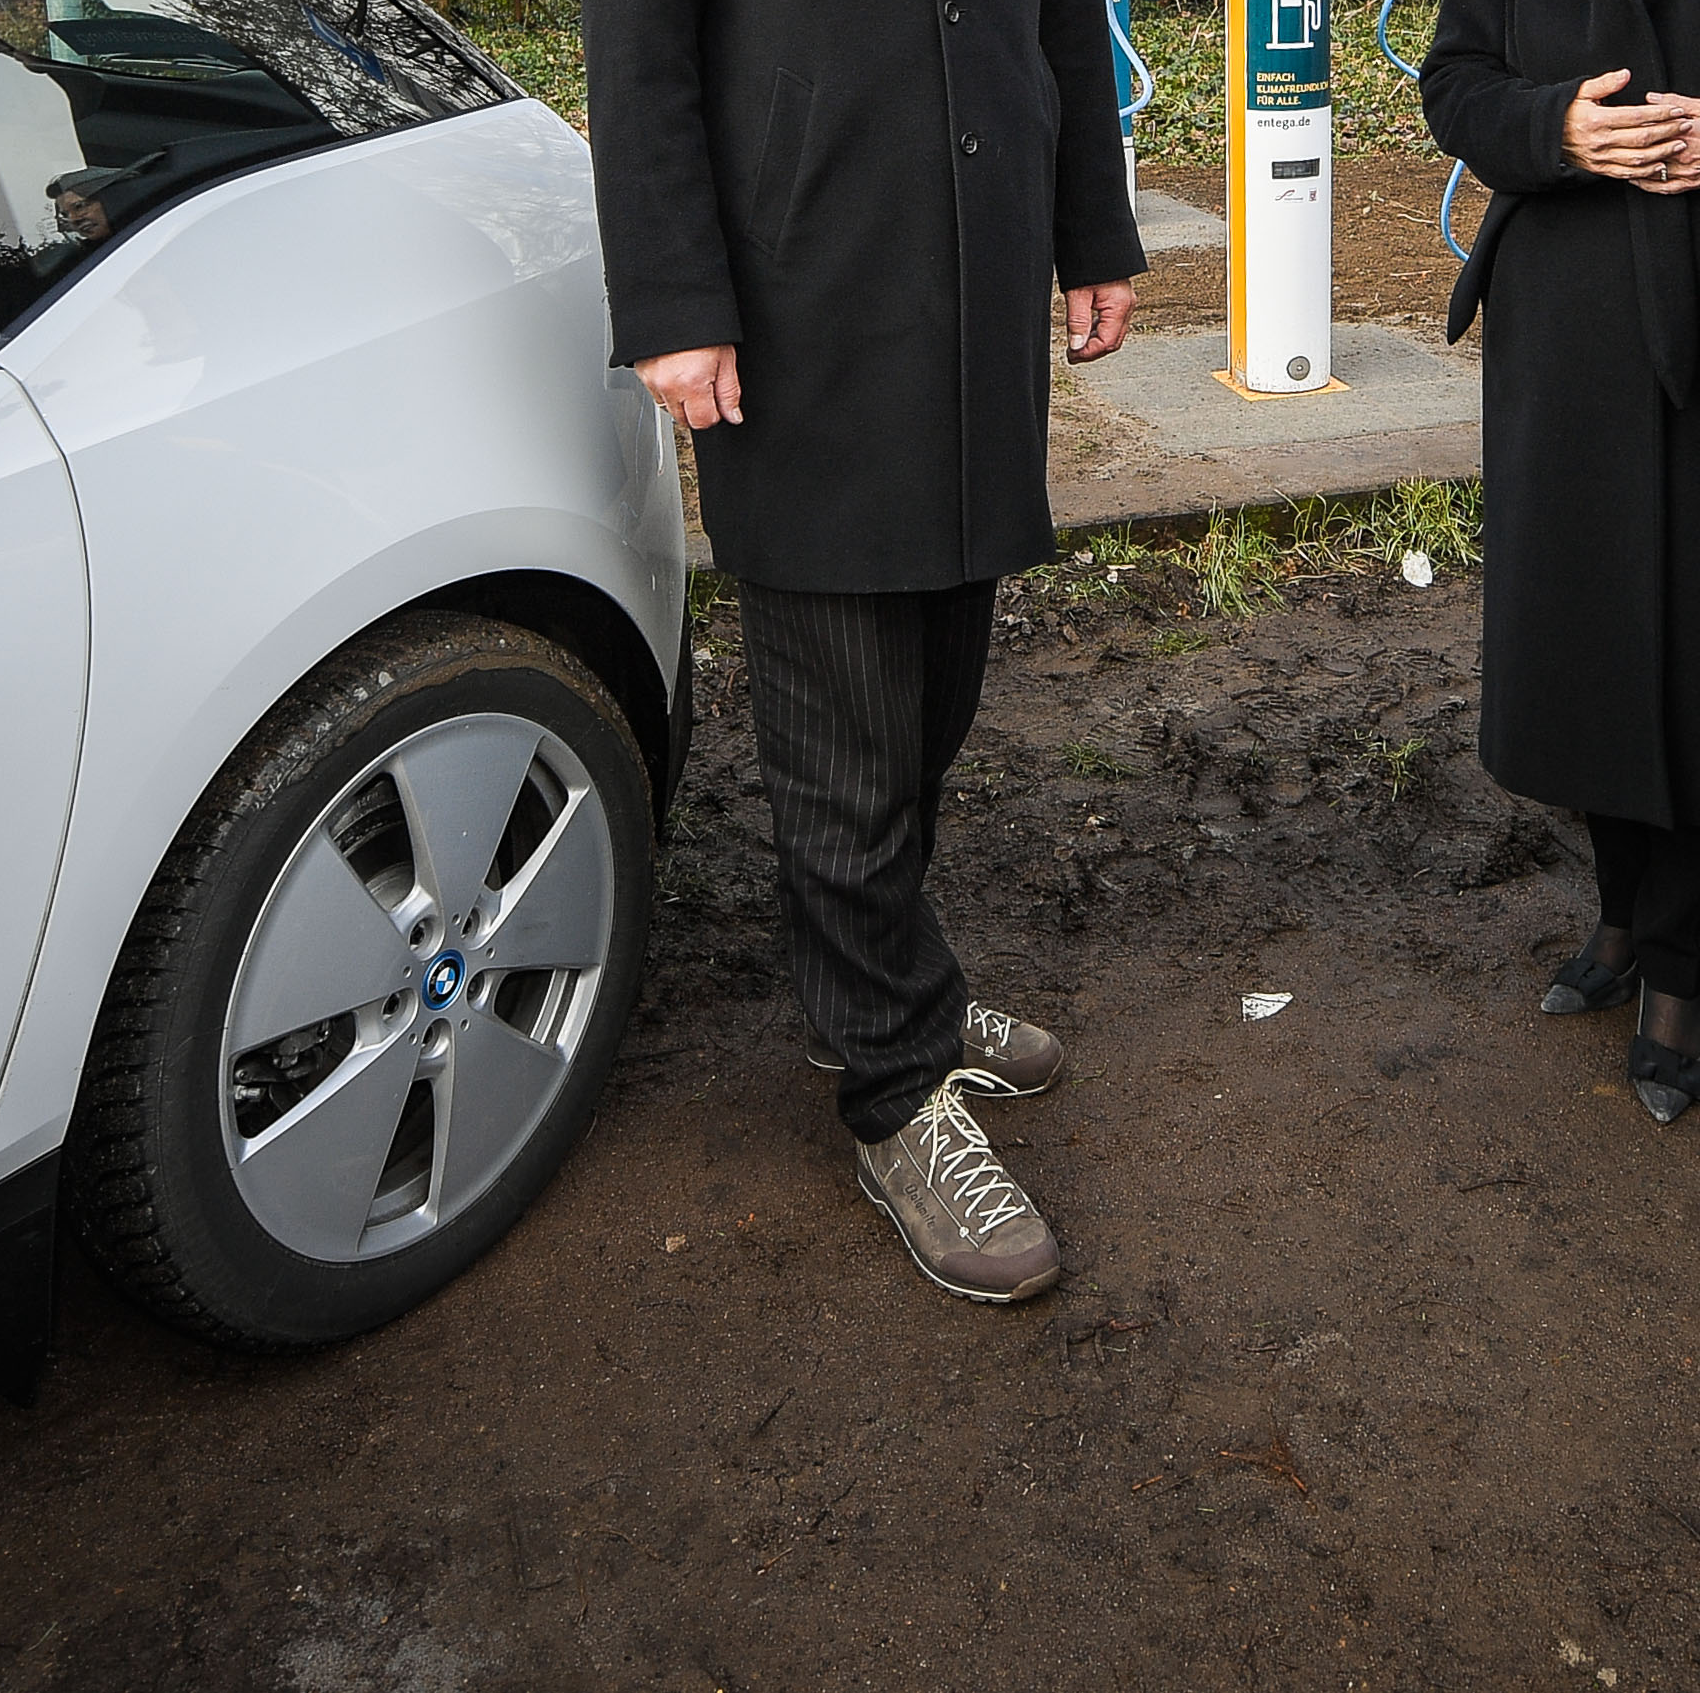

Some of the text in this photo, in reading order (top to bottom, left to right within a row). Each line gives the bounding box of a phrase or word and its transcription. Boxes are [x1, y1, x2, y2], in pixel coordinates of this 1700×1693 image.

[1256, 72, 1296, 82] EINFACH
[1256, 94, 1302, 106] FÜR ALLE.
[1257, 115, 1311, 130] entega.de
